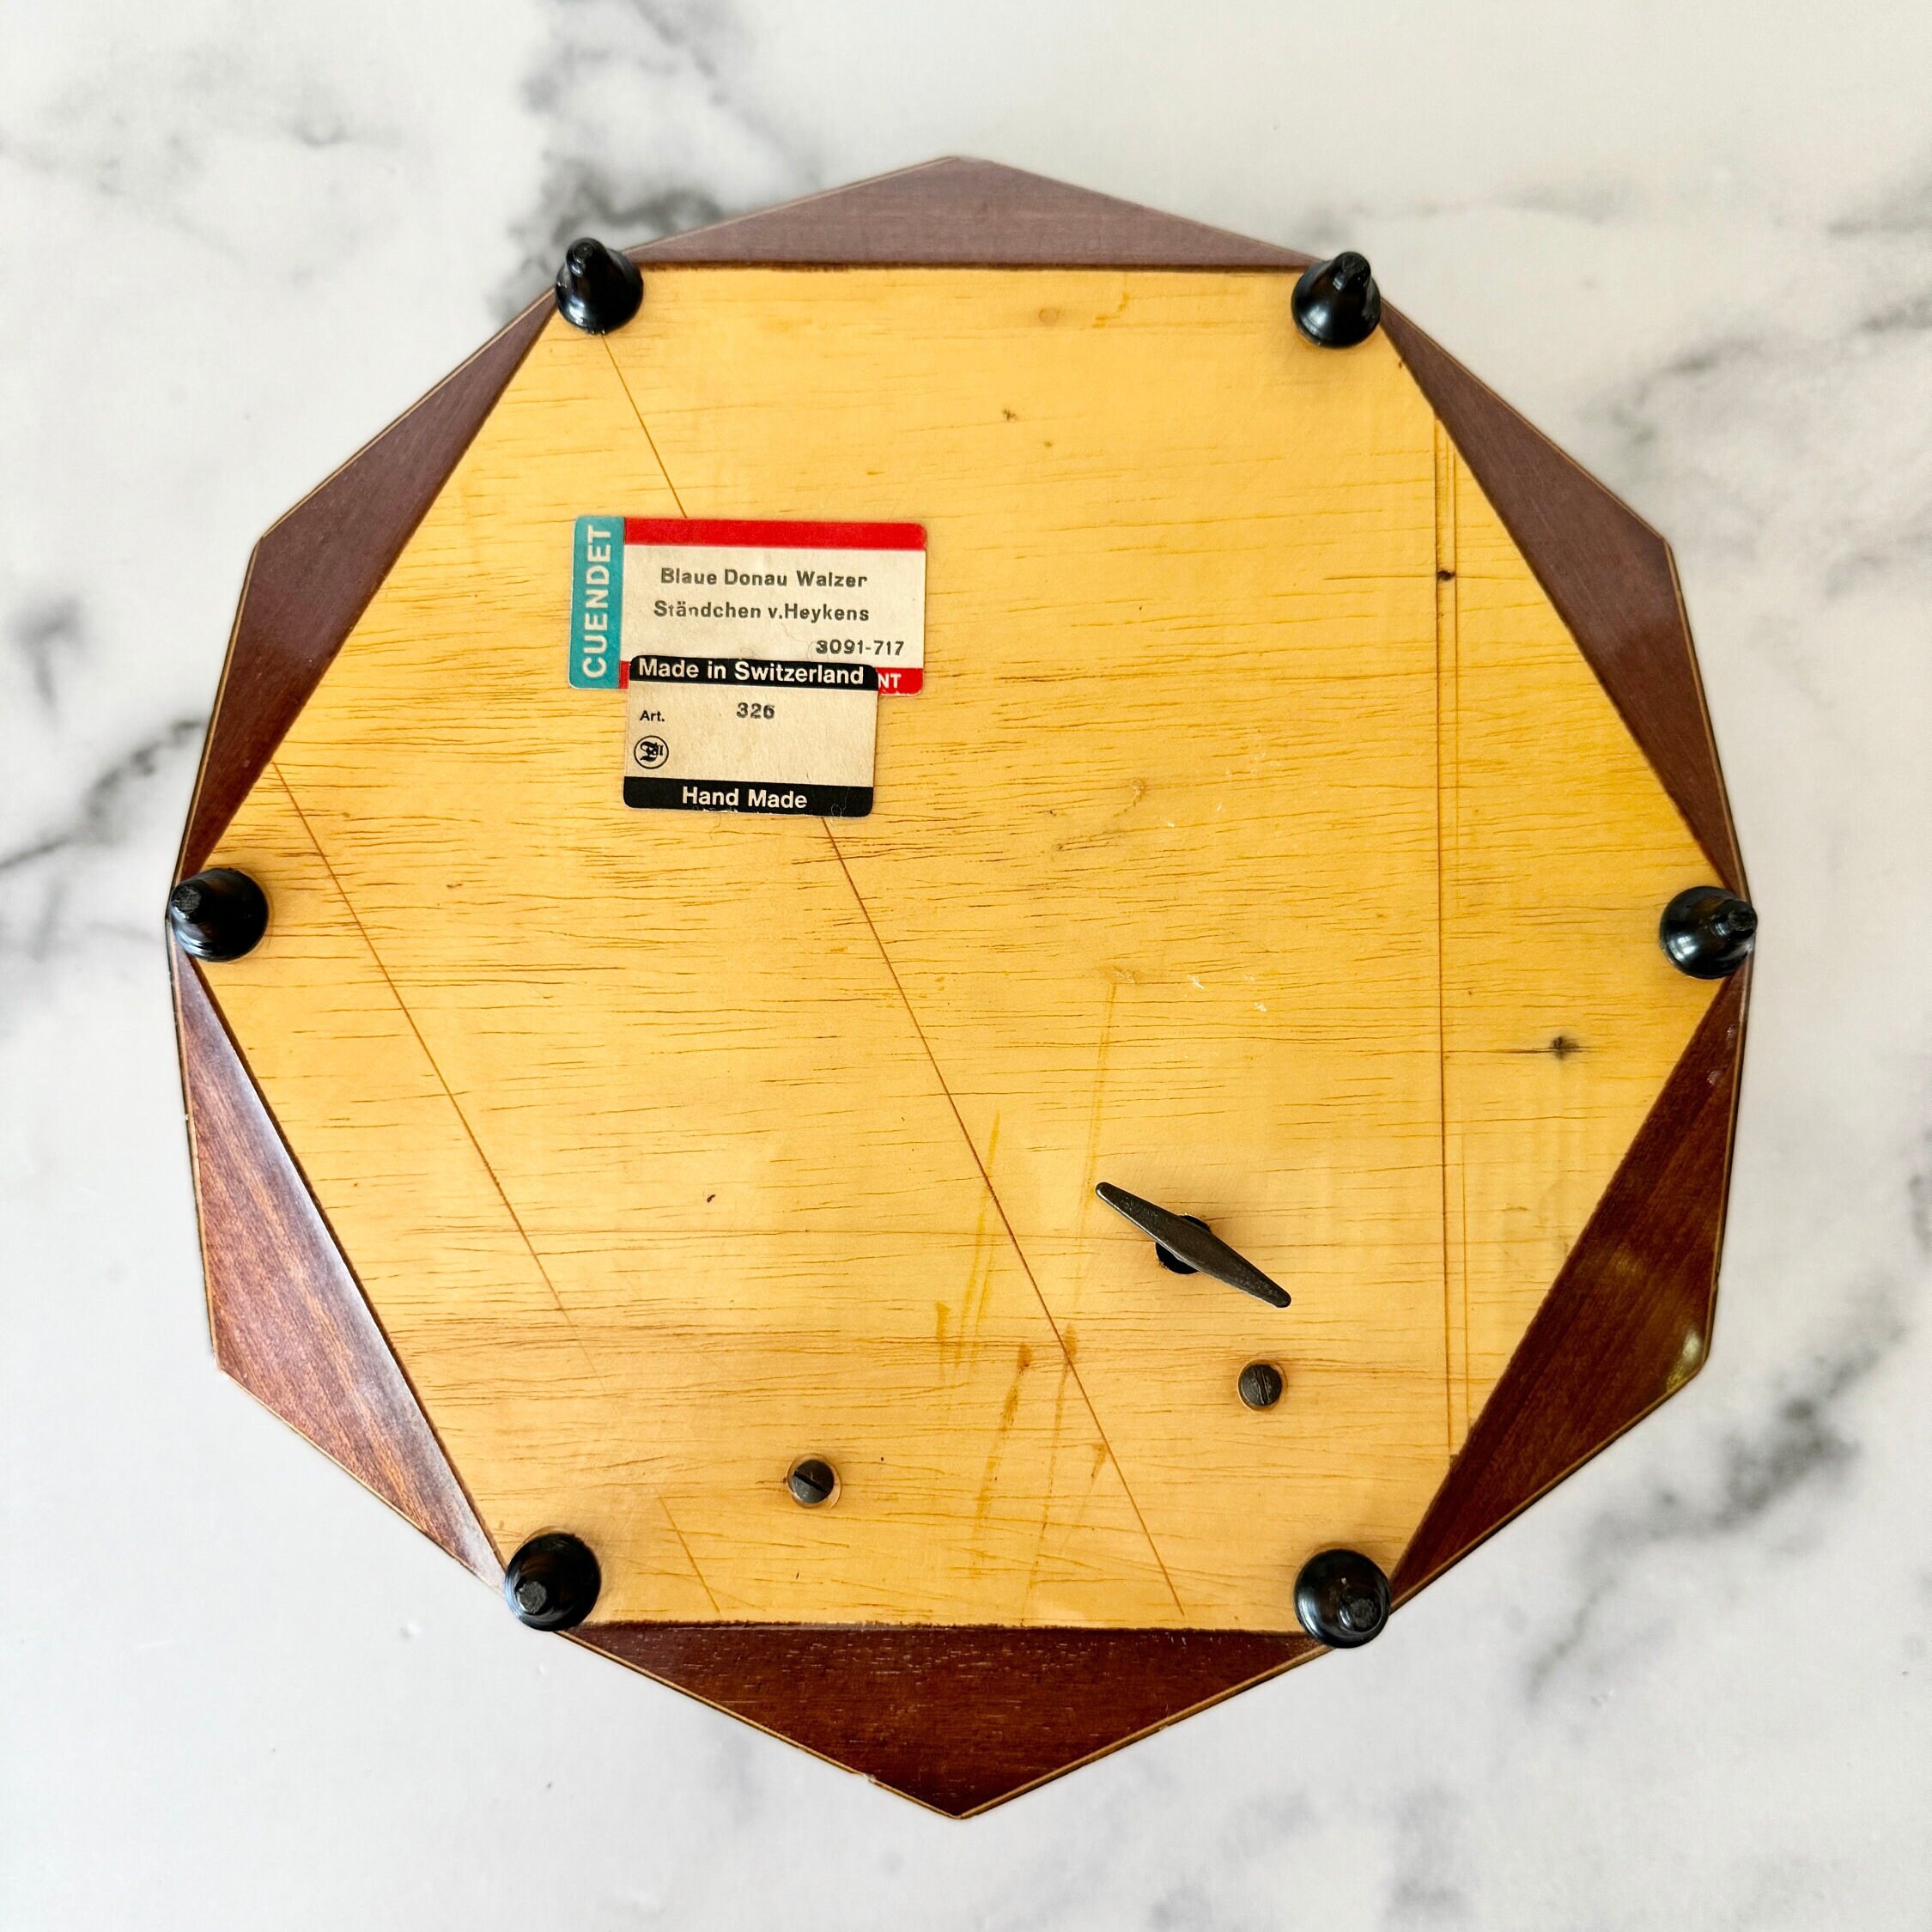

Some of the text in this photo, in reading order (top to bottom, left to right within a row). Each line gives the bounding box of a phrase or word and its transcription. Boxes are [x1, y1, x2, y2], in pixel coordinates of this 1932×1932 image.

[660, 567, 868, 588] Blaue Donau Walzer
[581, 525, 611, 678] CUENDET
[653, 600, 762, 619] Ständchen
[816, 639, 905, 657] 3091-717
[638, 658, 700, 679] Made
[707, 660, 726, 680] in
[734, 660, 864, 685] Switzerland
[640, 702, 775, 722] Art. 326
[682, 786, 808, 810] Hand Made
